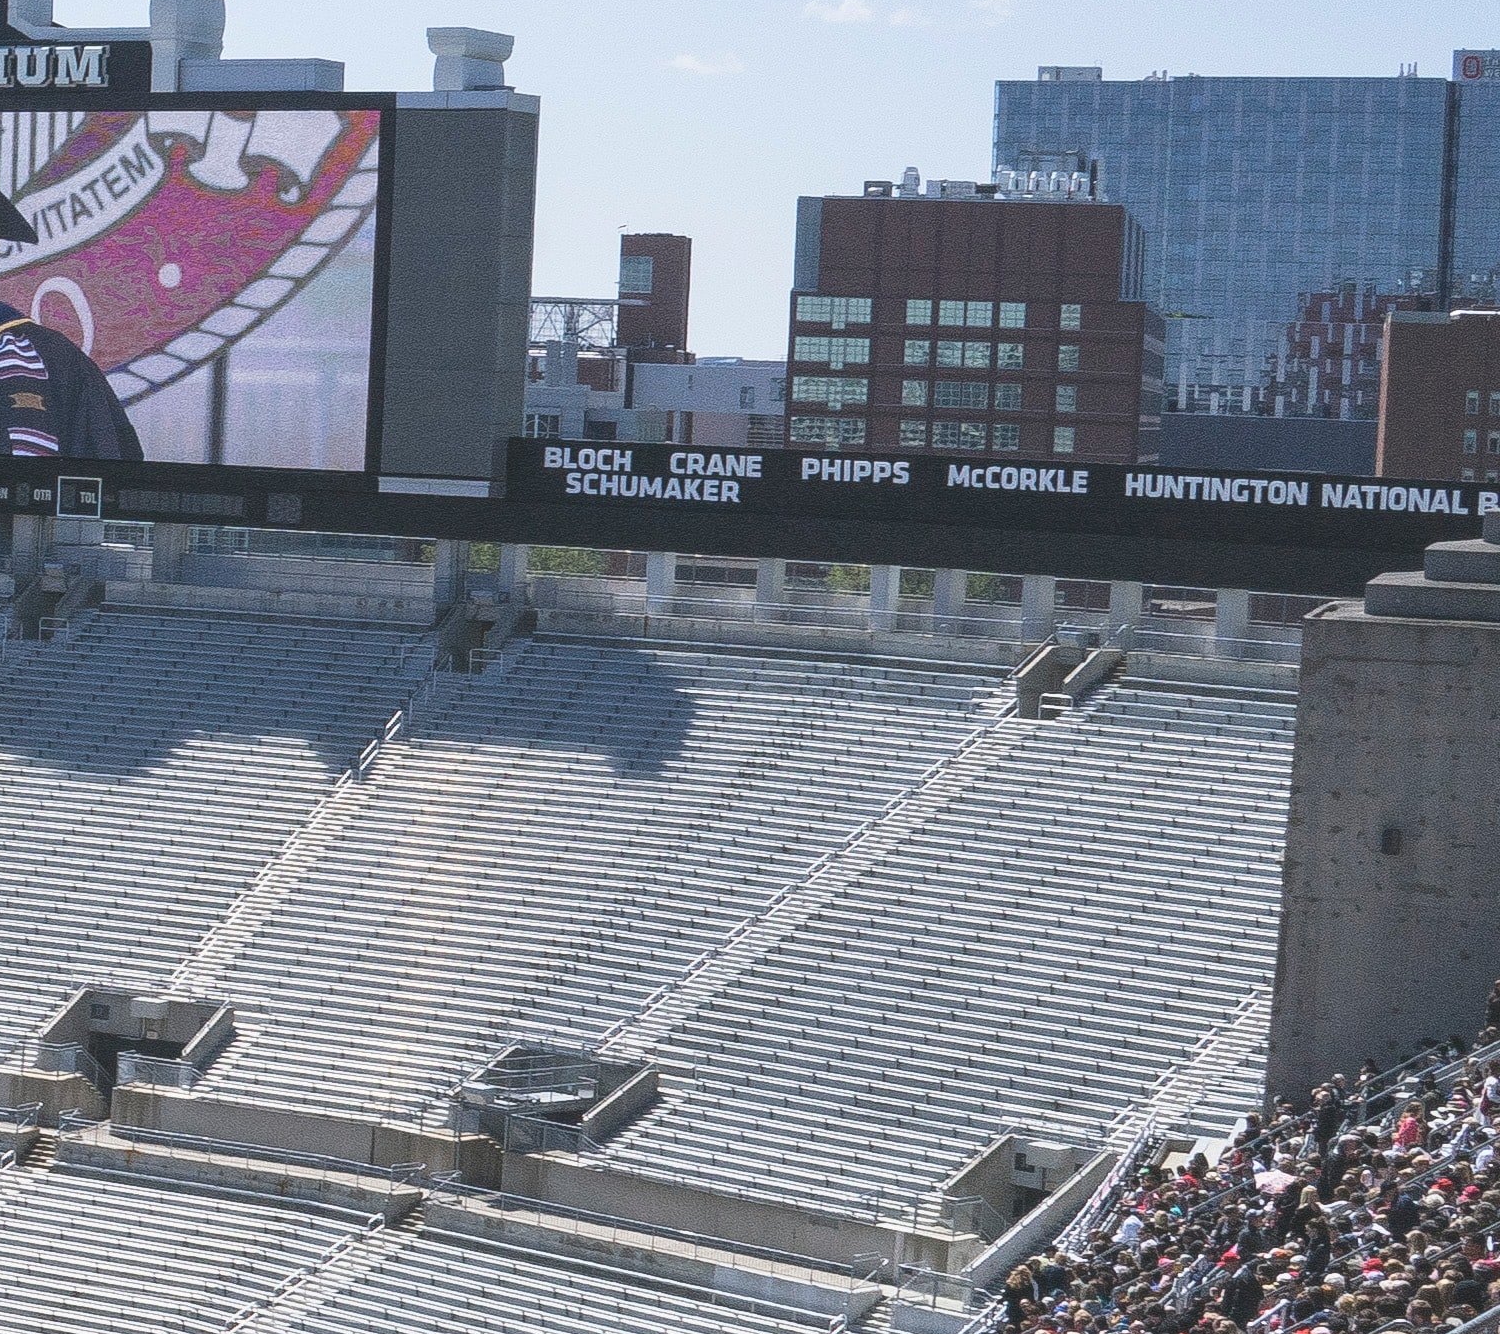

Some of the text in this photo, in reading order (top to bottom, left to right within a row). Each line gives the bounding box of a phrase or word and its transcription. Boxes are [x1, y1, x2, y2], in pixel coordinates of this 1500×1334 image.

[543, 446, 633, 472] BLOCH
[669, 452, 762, 478] CRANE
[801, 457, 910, 484] PHIPPS
[565, 472, 740, 503] SCHUMAKER
[947, 464, 1087, 494] McCORKLE
[1125, 473, 1309, 506] HUNTINGTON
[1321, 483, 1468, 516] NATIONAL
